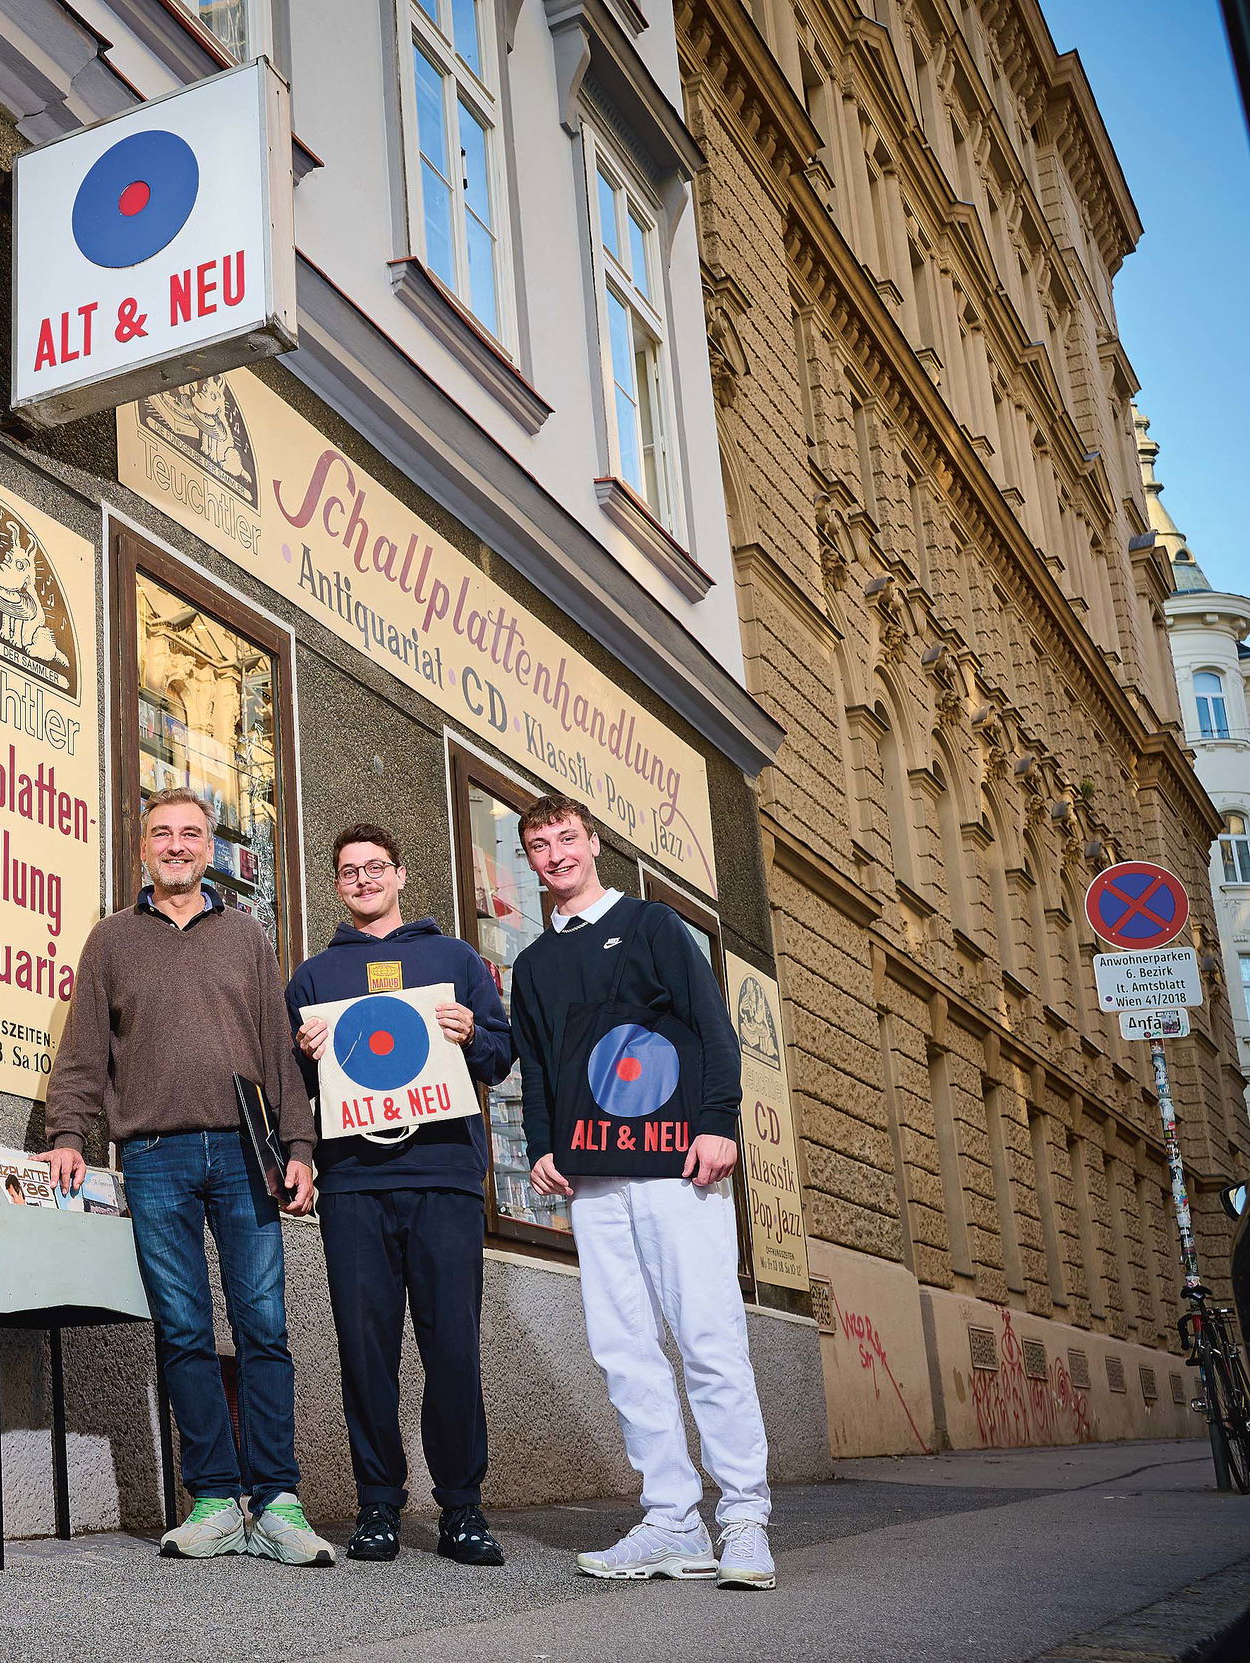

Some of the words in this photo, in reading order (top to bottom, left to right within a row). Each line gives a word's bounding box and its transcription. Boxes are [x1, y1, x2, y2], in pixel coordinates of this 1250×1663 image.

[34, 302, 98, 372] ALT
[115, 297, 148, 343] &
[170, 250, 245, 326] NEU
[137, 431, 261, 555] Teuchtler
[273, 450, 682, 828] Schallplattenhandlung
[3, 649, 20, 662] DER
[21, 657, 59, 683] SAMMLER
[297, 543, 444, 690] Antiquariat
[461, 666, 507, 734] CD
[523, 711, 597, 800] Klassik
[605, 767, 636, 837] Pop
[650, 807, 686, 861] Jazz
[1100, 951, 1191, 967] Anwohnerparken
[1126, 969, 1136, 979] 6.
[1140, 967, 1173, 978] Bezirk
[1116, 983, 1129, 994] lt.
[1132, 979, 1186, 993] Amtsblatt
[1116, 995, 1142, 1007] Wien
[1145, 993, 1187, 1005] 41/2018
[1129, 1015, 1181, 1031] Anfa
[342, 1096, 374, 1130] ALT
[383, 1097, 402, 1120] &
[407, 1083, 451, 1117] NEU
[755, 1101, 780, 1145] CD
[570, 1119, 611, 1151] ALT
[616, 1125, 637, 1150] &
[644, 1121, 689, 1152] NEU
[748, 1143, 797, 1194] Klassik
[751, 1188, 772, 1239] Pop
[775, 1197, 802, 1244] Jazz
